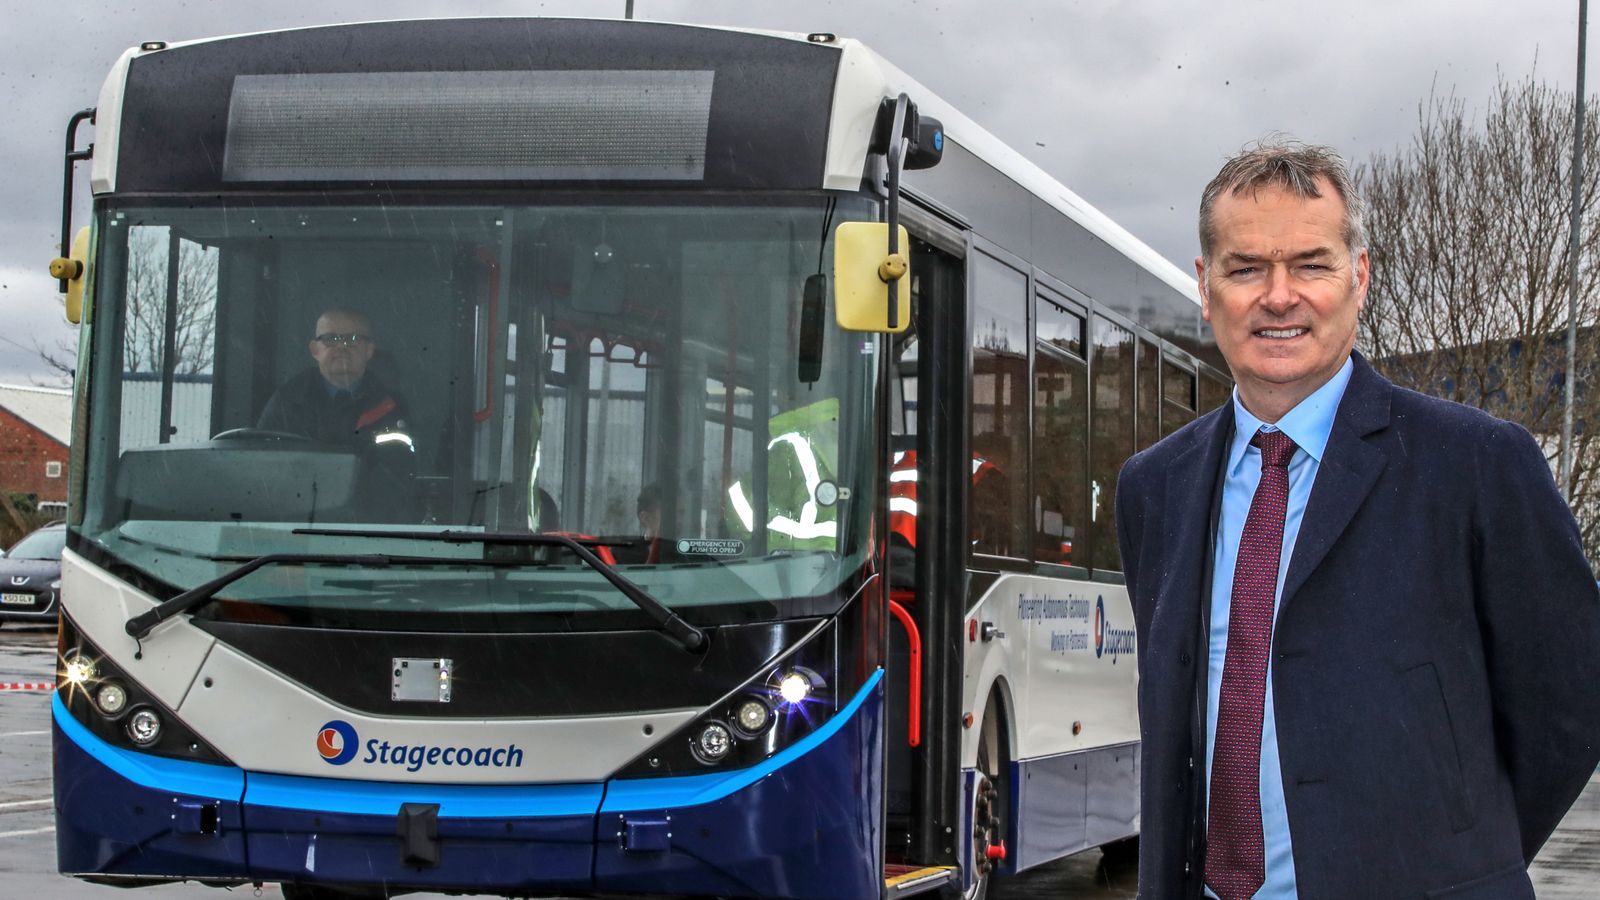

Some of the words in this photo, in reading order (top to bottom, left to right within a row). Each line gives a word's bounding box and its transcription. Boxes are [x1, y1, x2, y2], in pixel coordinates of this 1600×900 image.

[1018, 593, 1042, 625] Pioneering
[1043, 593, 1068, 619] Autonomous
[1068, 593, 1090, 624] Technology
[1104, 621, 1136, 664] Stagecoach
[364, 739, 524, 772] Stagecoach
